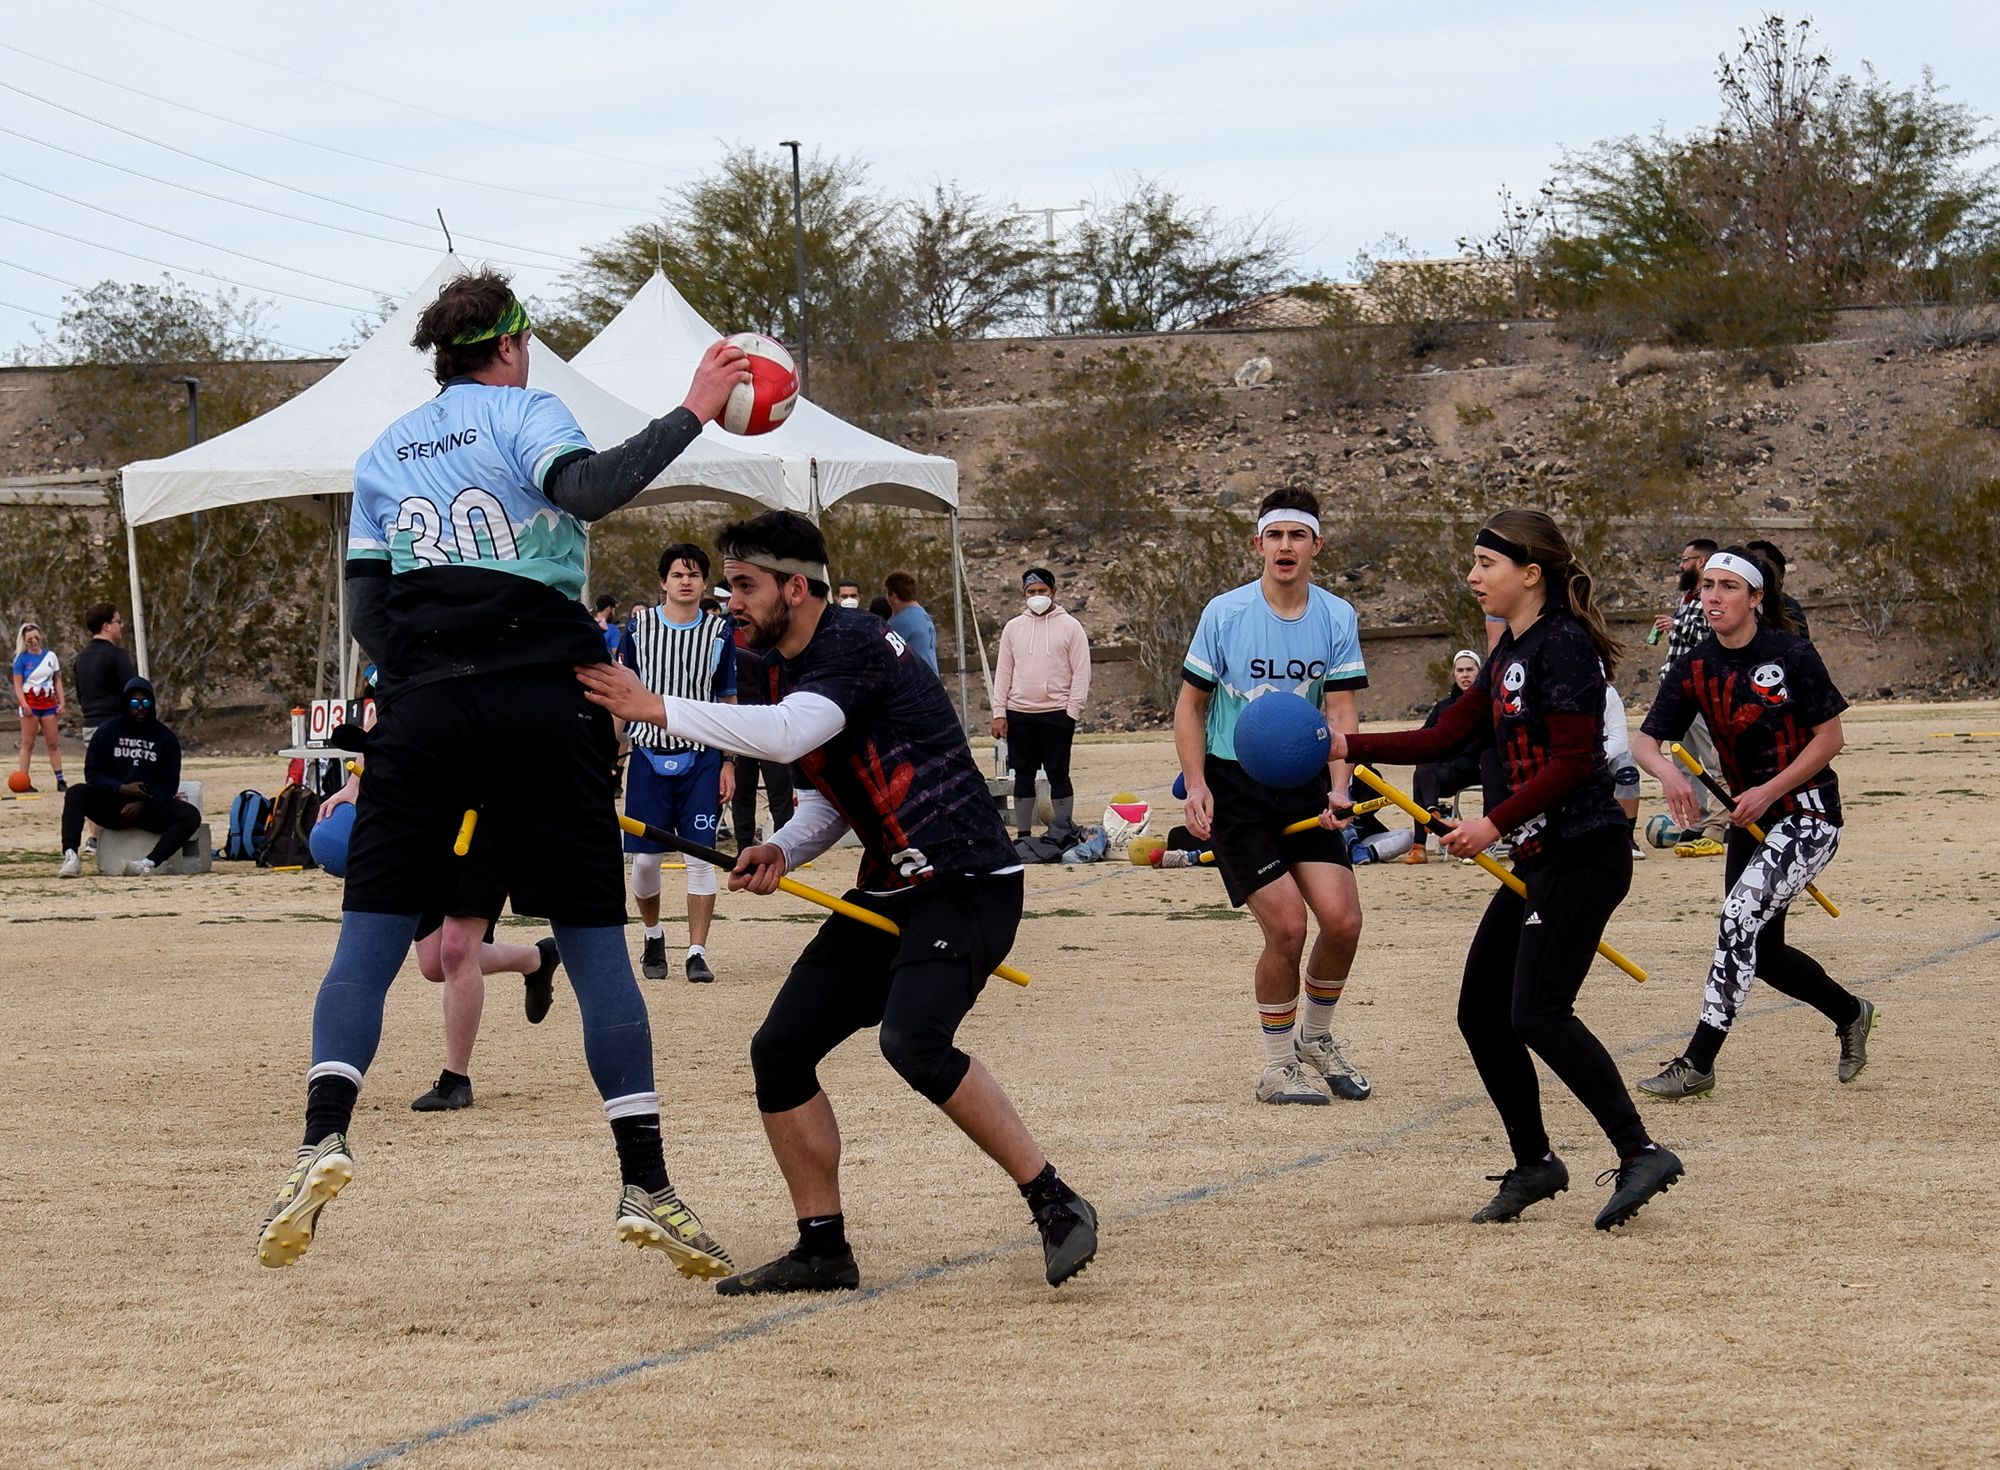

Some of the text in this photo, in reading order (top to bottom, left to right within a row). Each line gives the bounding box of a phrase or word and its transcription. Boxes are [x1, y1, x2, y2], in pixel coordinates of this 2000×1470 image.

[396, 487, 520, 567] 30
[1250, 658, 1327, 681] SLQC
[113, 746, 157, 762] BUCKTS
[1796, 788, 1826, 813] 11
